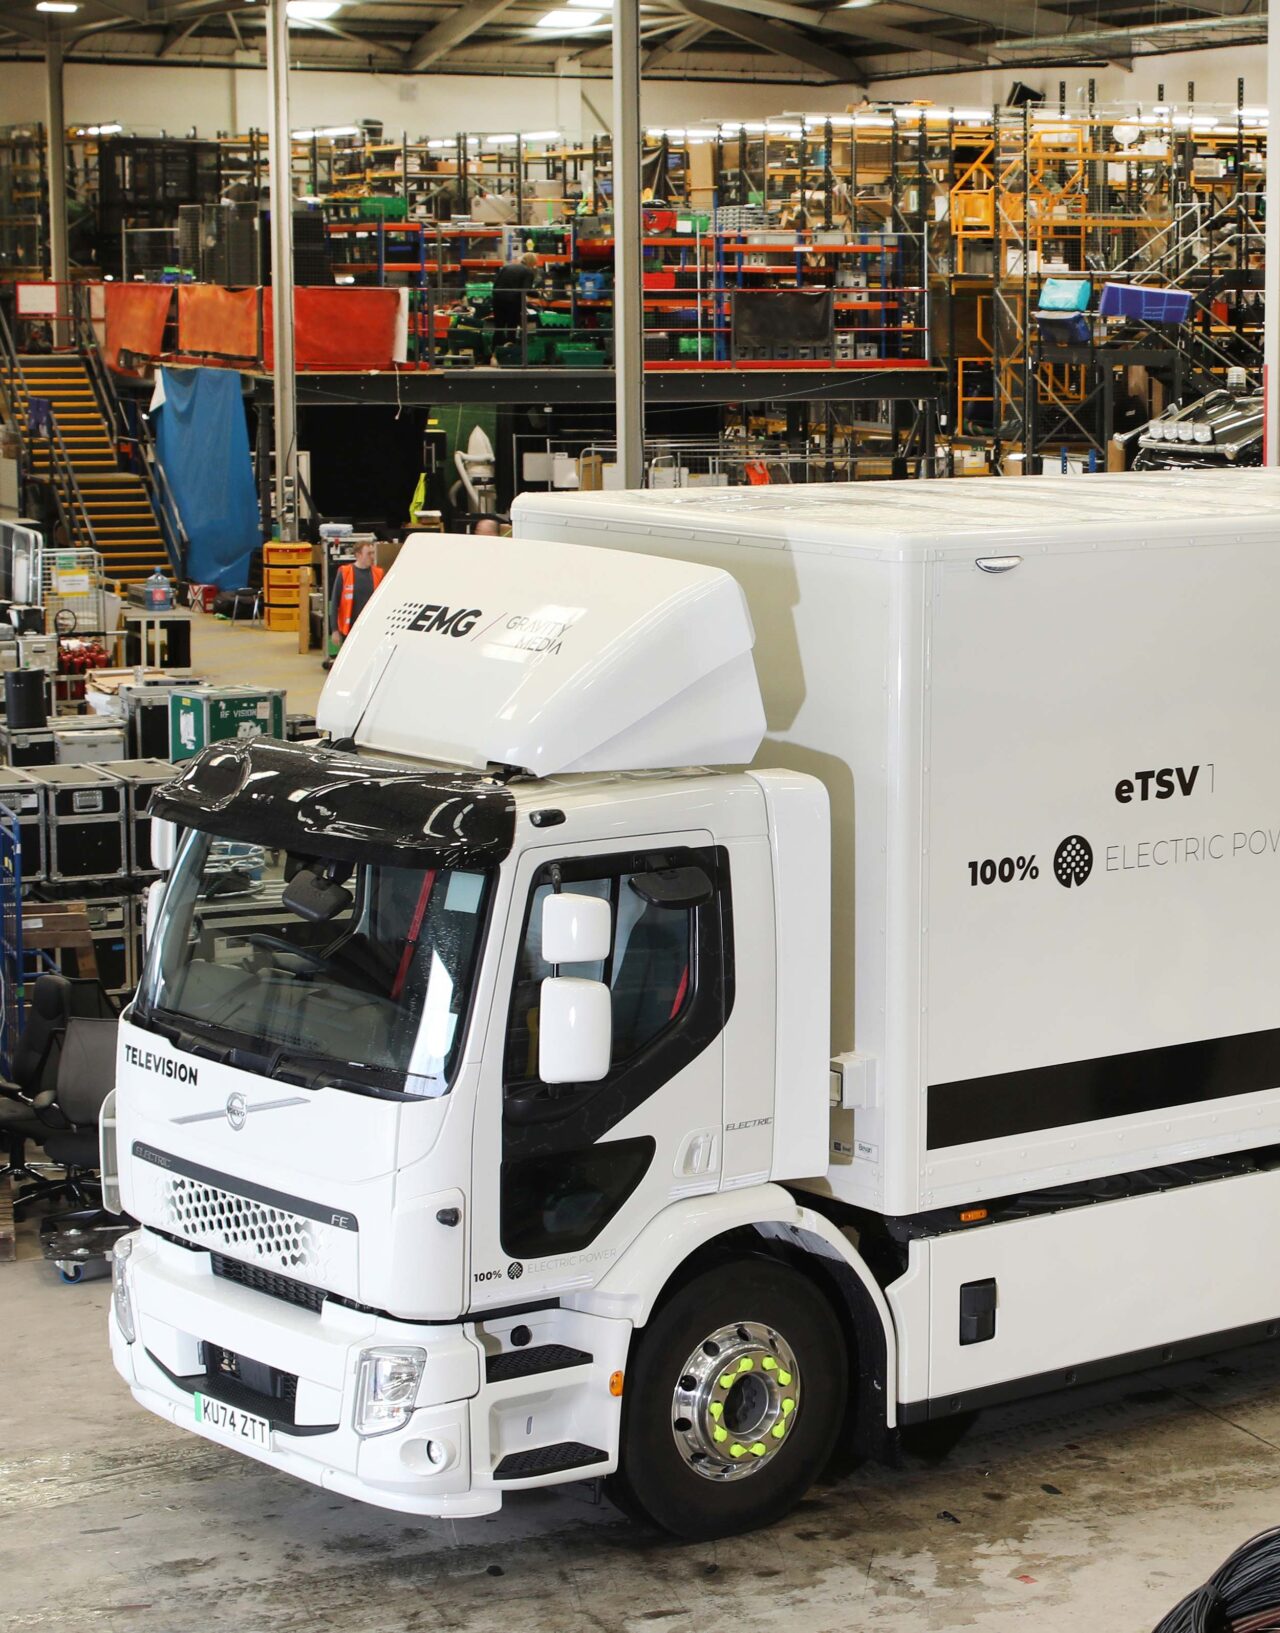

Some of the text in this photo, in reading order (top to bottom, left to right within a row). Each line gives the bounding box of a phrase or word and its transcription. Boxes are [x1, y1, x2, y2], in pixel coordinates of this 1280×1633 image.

[407, 604, 482, 638] EMG
[506, 616, 573, 638] GRAVITY
[515, 637, 562, 655] MEDIA
[1115, 763, 1215, 804] eTSV 1
[968, 854, 1039, 886] 100%
[1106, 834, 1225, 871] ELECTRIC
[125, 1044, 198, 1086] TELEVISION
[726, 1116, 773, 1131] ELECTRIC
[331, 1214, 349, 1229] FE
[474, 1248, 617, 1282] 100% ELECTRIC POWER
[203, 1398, 266, 1443] KU74 ZTT
